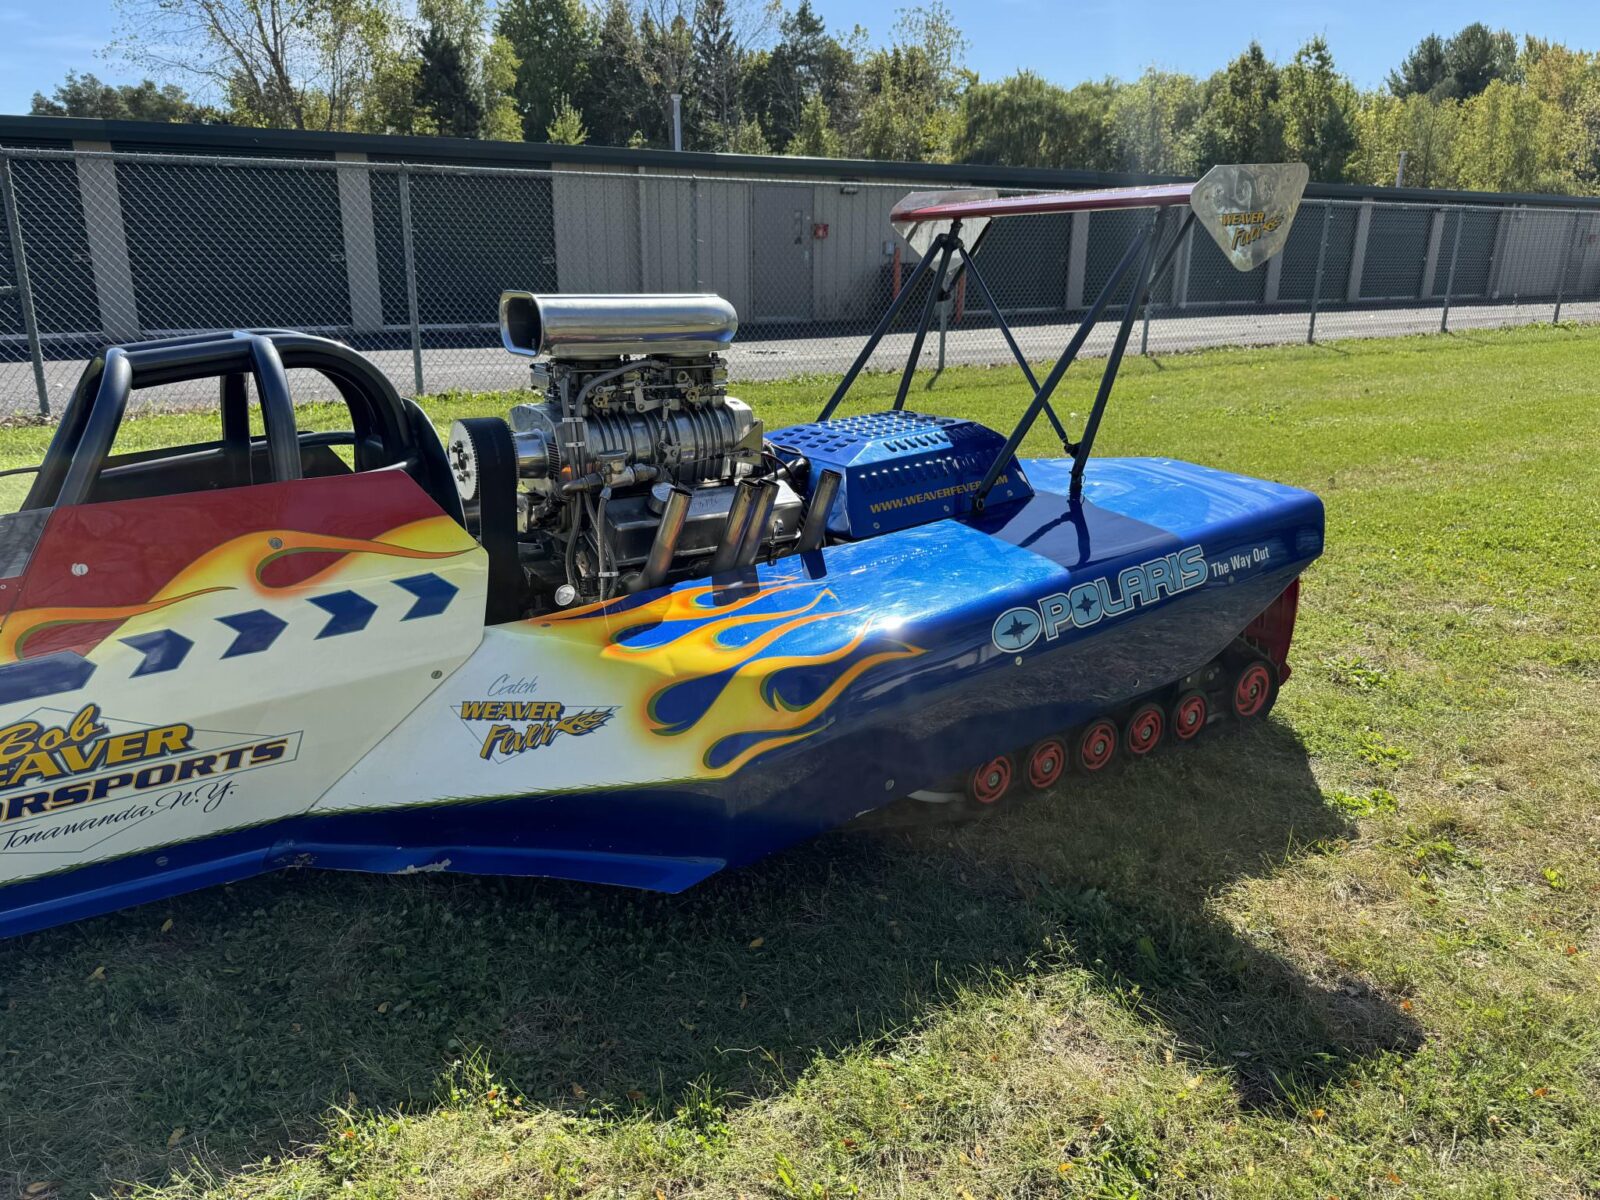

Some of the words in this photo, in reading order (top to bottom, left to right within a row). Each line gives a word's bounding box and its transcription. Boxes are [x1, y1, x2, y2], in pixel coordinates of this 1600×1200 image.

[1222, 211, 1265, 226] WEAVER
[1211, 561, 1230, 577] The
[1230, 554, 1251, 570] Way
[1252, 546, 1270, 562] Out
[1039, 545, 1208, 641] POLARIS
[487, 673, 539, 697] Catch
[461, 701, 565, 721] WEAVER
[0, 703, 106, 762] Bob
[479, 721, 556, 760] Fever
[0, 722, 197, 790] AVER
[0, 738, 289, 821] RSPORTS
